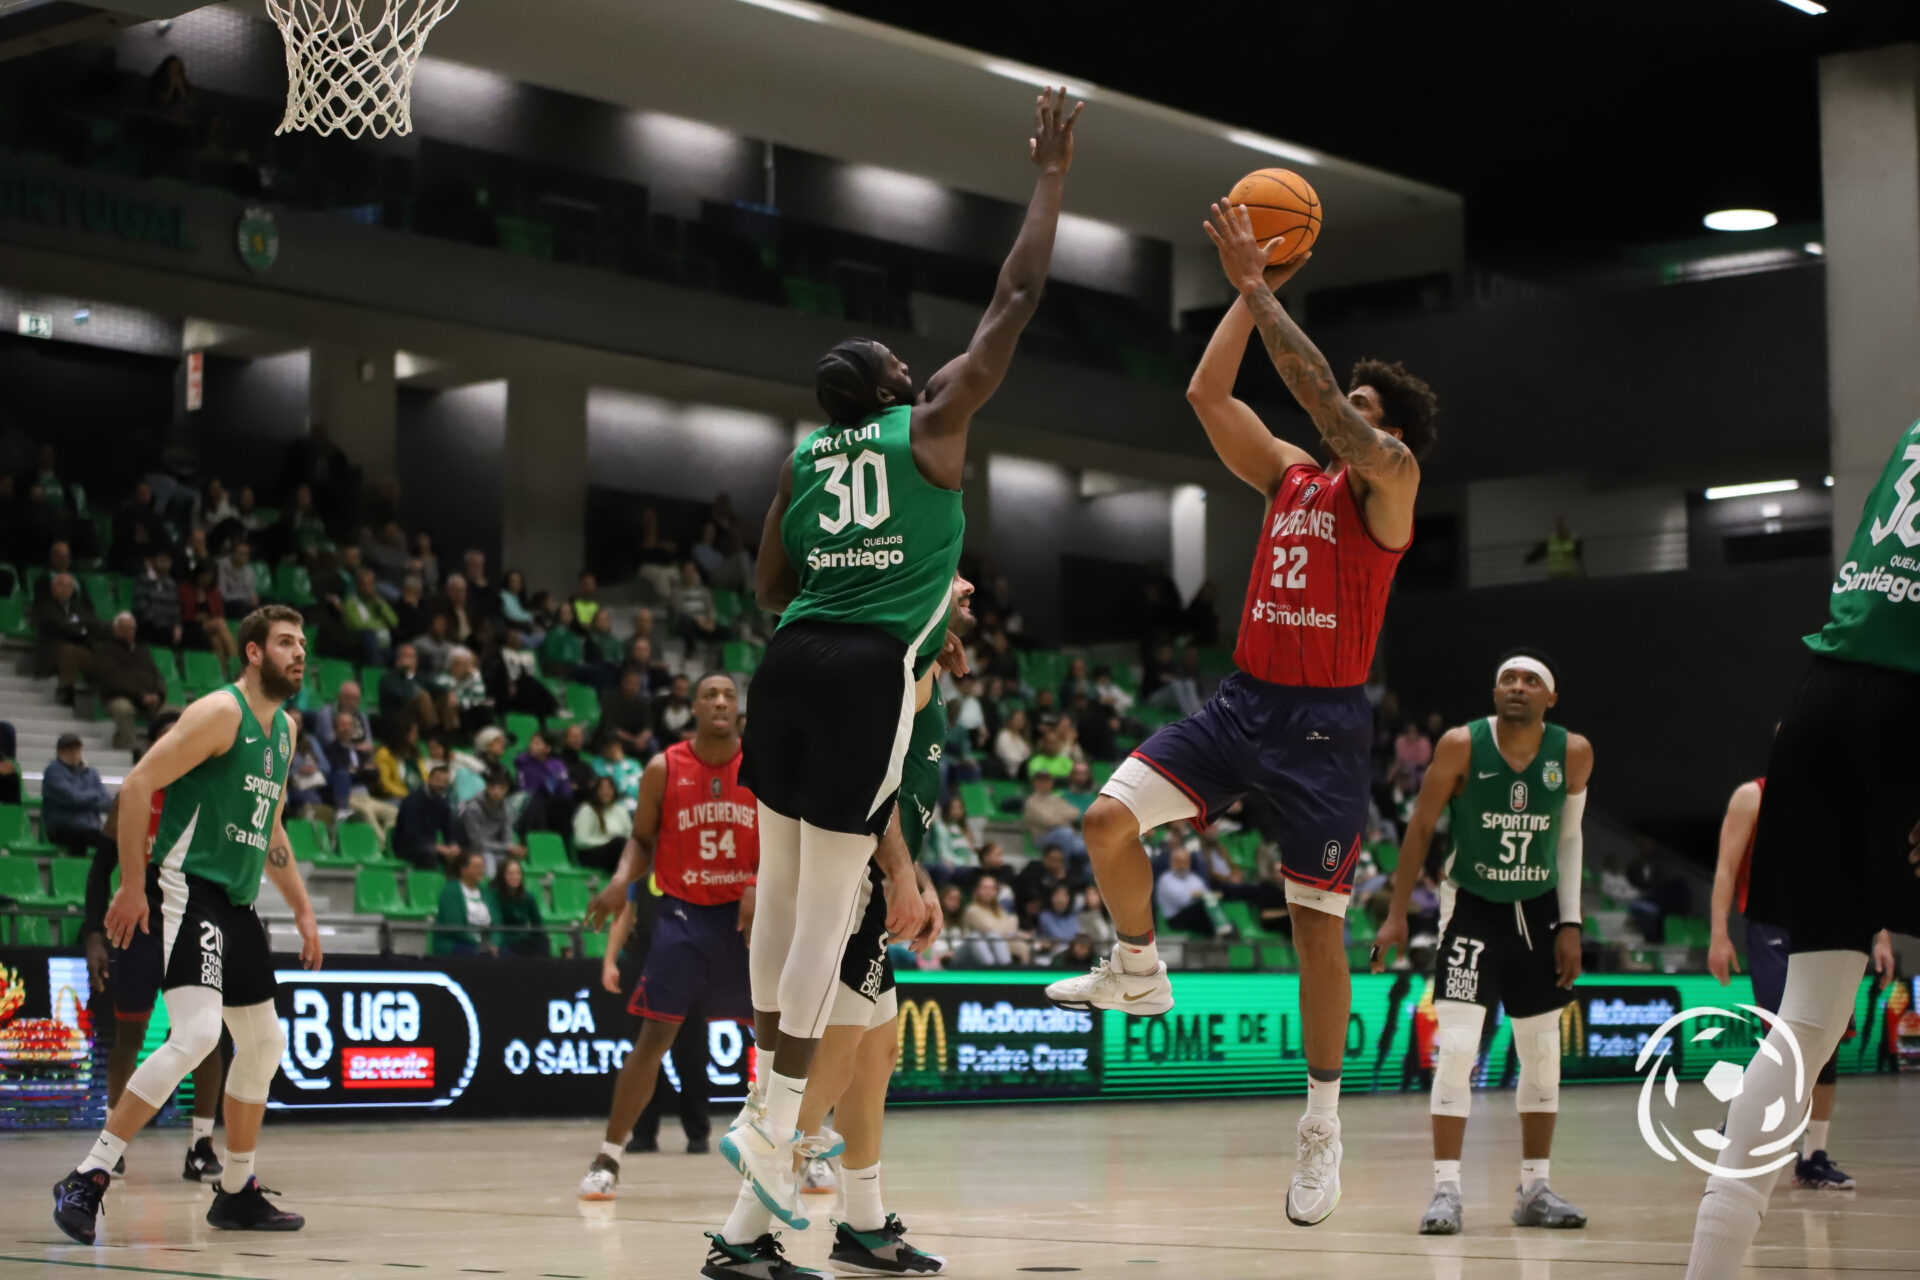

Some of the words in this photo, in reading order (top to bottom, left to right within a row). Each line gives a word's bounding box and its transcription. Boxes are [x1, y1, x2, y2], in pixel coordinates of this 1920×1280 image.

[815, 449, 890, 535] 30
[863, 535, 903, 547] QUEIJOS
[807, 547, 904, 571] Santiago
[1270, 546, 1308, 589] 22
[251, 795, 271, 831] 20
[678, 801, 756, 831] OLIVEIRENSE
[1482, 812, 1551, 831] SPORTING
[699, 829, 737, 860] 54
[1499, 831, 1533, 865] 57
[1487, 865, 1550, 881] auditiv
[200, 920, 223, 958] 20
[1448, 936, 1485, 970] 57
[1446, 977, 1478, 992] QUILI
[1447, 967, 1479, 981] TRAN
[1446, 987, 1477, 1002] DADE
[548, 988, 596, 1034] DÁ
[1124, 1013, 1225, 1064] FOME
[1238, 1013, 1268, 1044] DE
[504, 1040, 531, 1076] O
